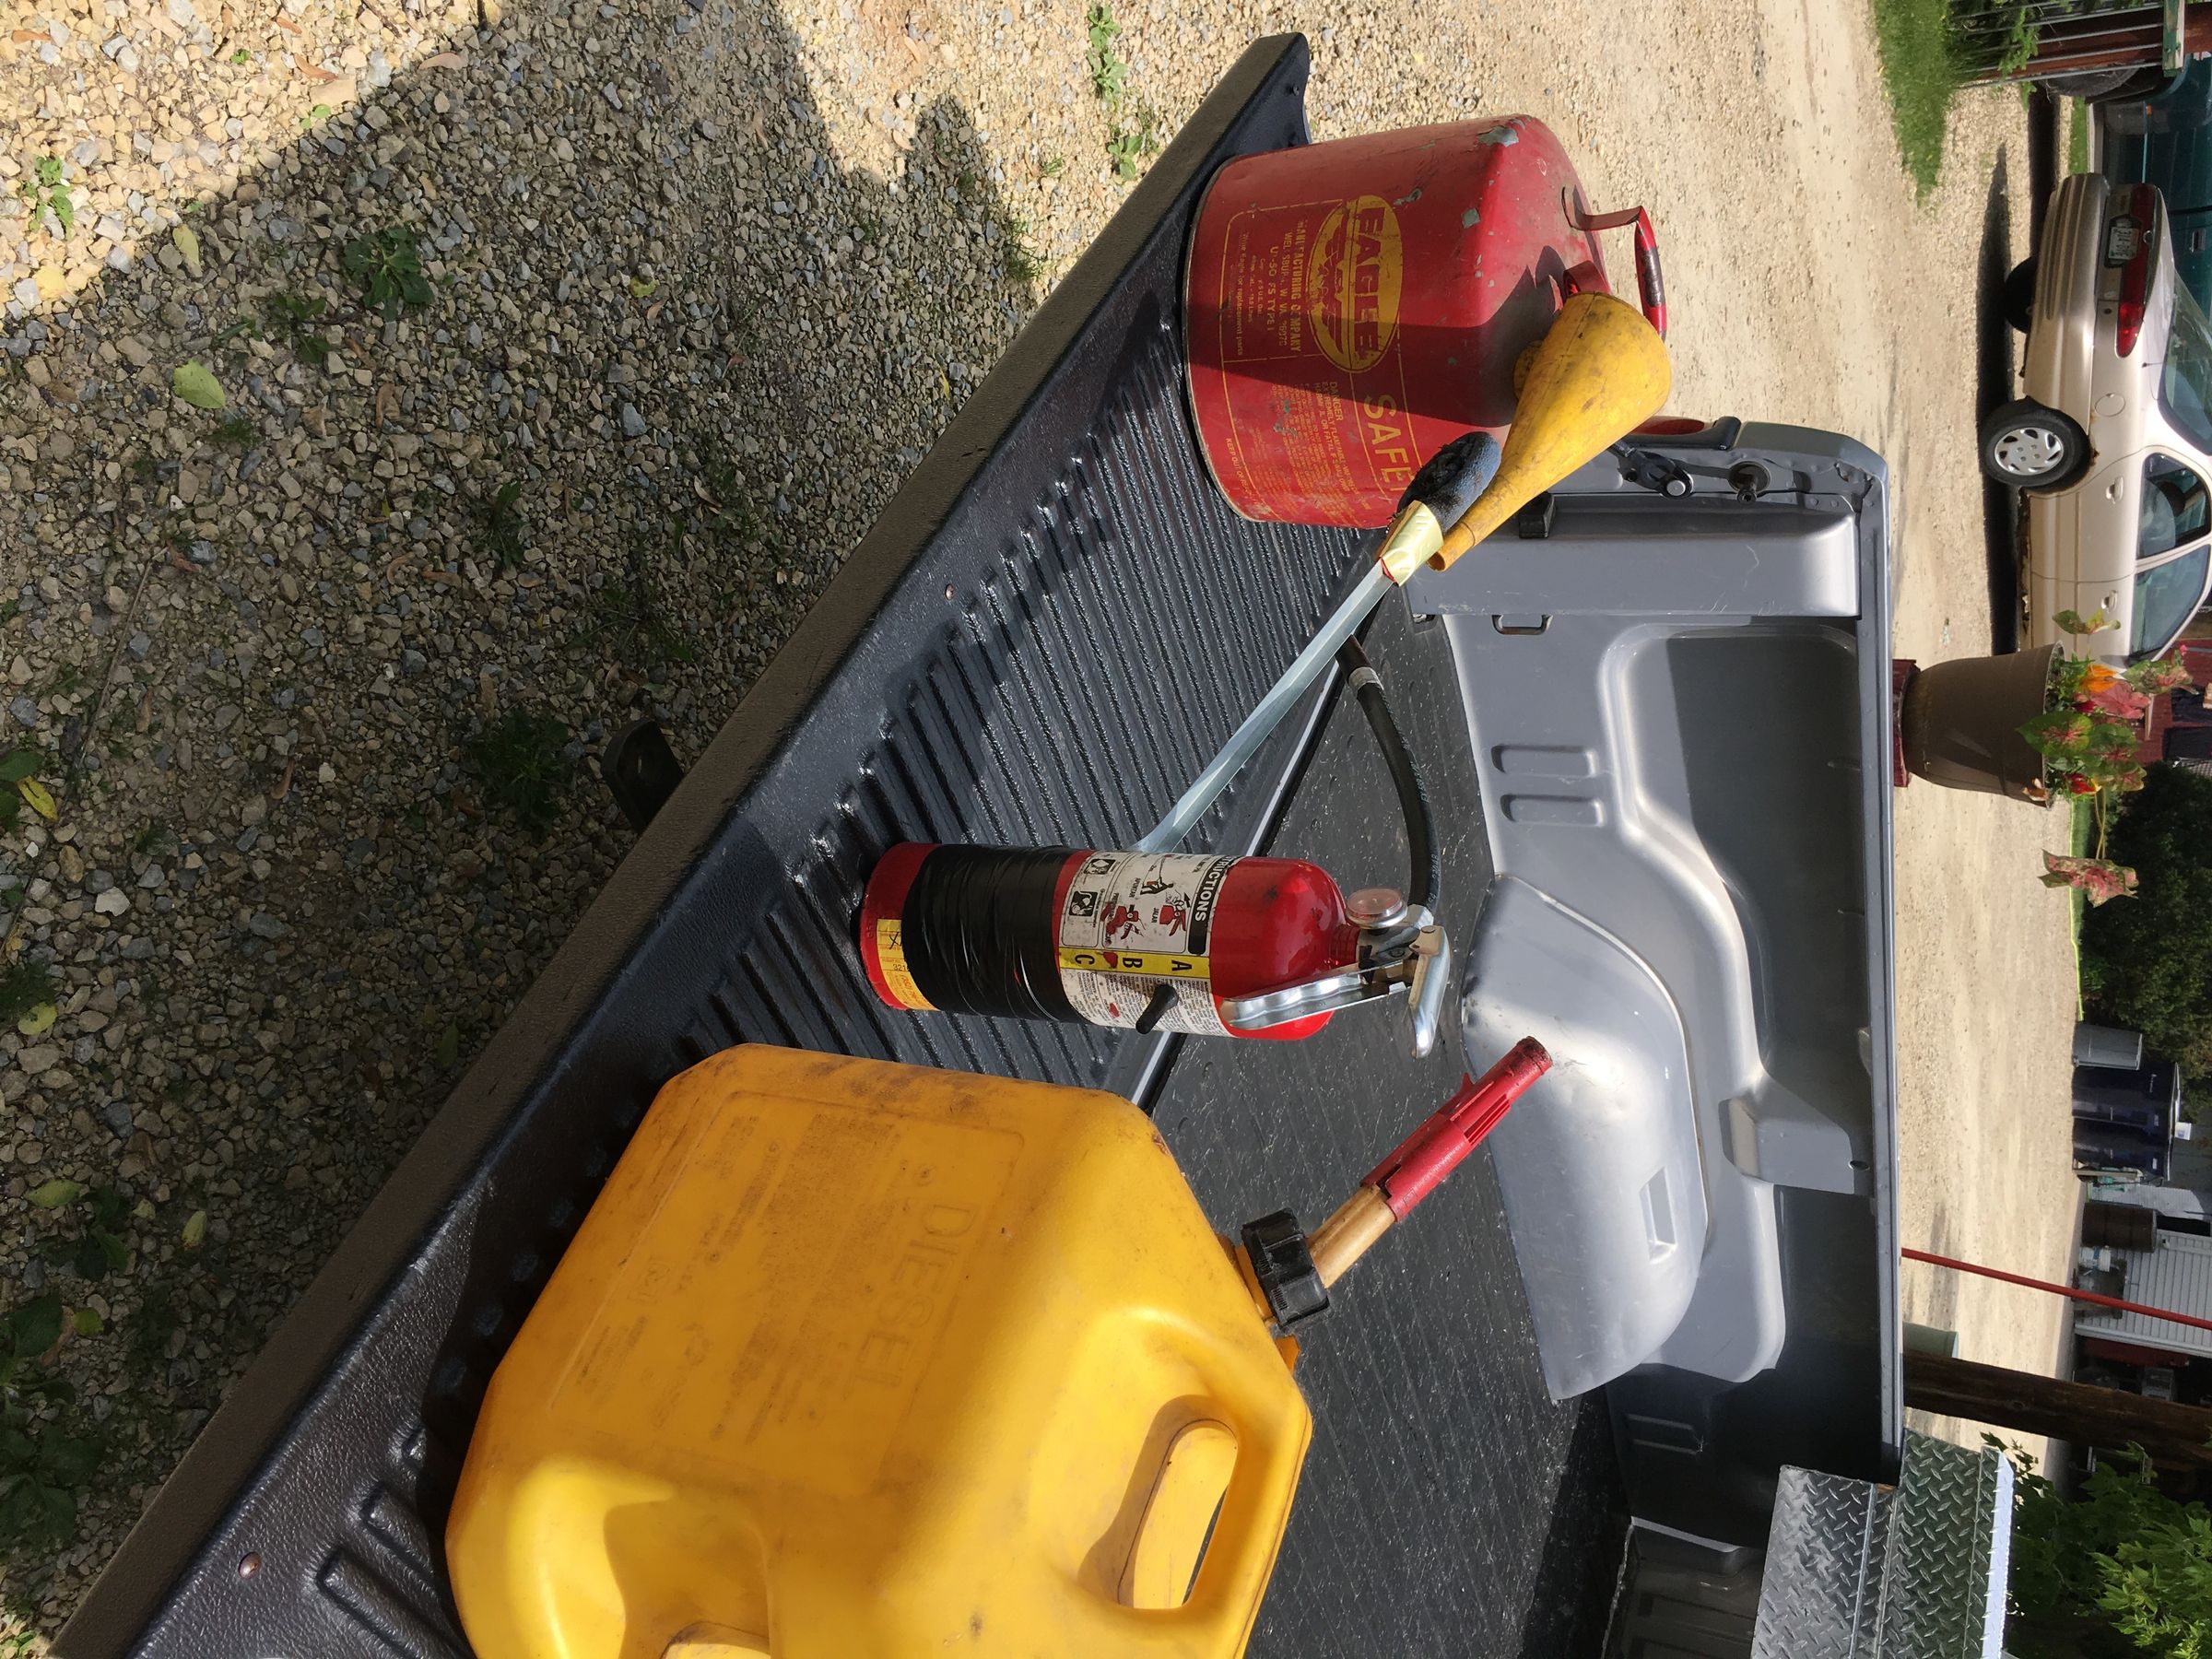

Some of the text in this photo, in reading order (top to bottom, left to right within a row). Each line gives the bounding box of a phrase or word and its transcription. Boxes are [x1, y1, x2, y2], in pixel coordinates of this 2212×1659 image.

[1354, 207, 1385, 357] EAGLE
[1266, 299, 1276, 325] TYPE
[1235, 335, 1243, 356] parts
[1329, 382, 1344, 421] DANGER
[1321, 420, 1329, 429] OR
[1226, 438, 1237, 455] KEEP
[1324, 431, 1334, 452] FATAL
[1231, 457, 1242, 470] OUT
[1075, 954, 1095, 964] C
[1123, 957, 1143, 968] B
[1171, 959, 1193, 971] A
[852, 1202, 980, 1390] DIESEL
